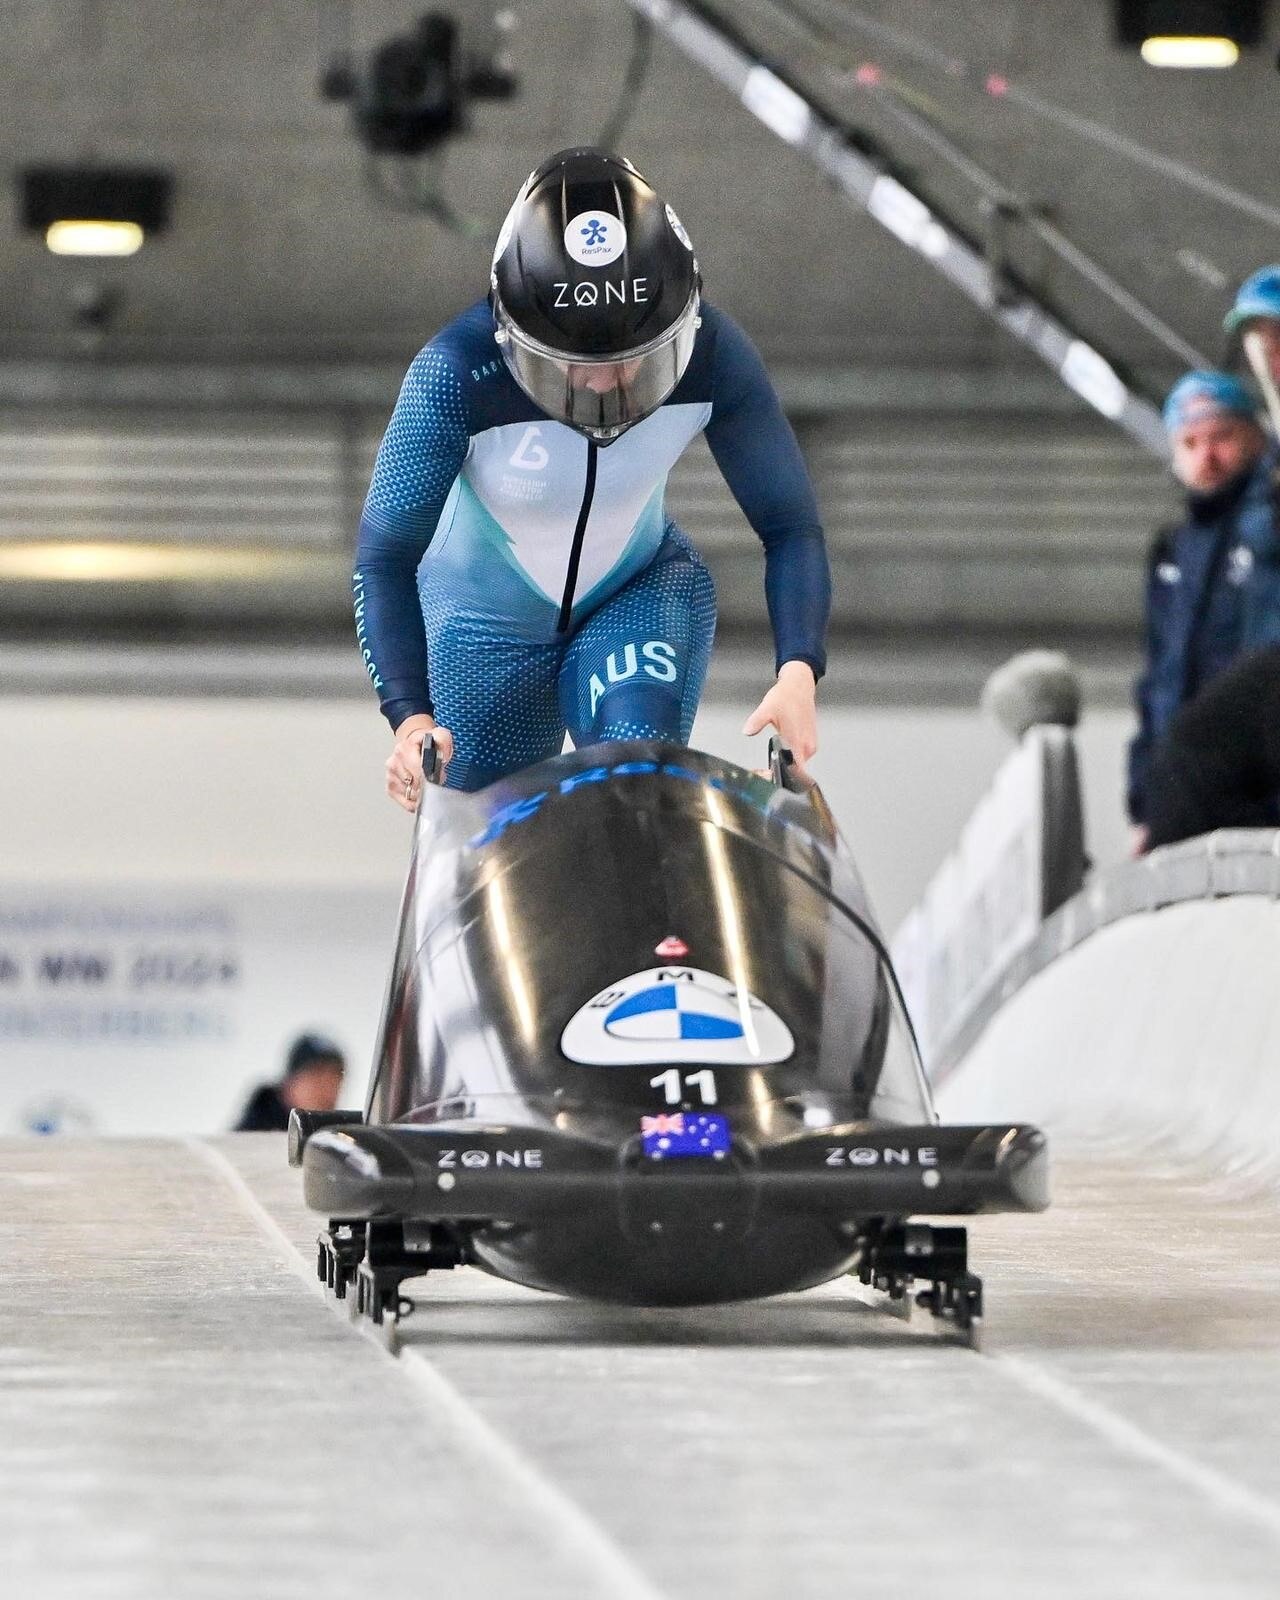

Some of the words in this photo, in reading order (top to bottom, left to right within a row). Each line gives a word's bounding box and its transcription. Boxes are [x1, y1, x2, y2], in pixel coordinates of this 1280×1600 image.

[552, 277, 649, 308] ZONE
[471, 359, 502, 382] BAB
[588, 640, 677, 718] AUS
[649, 1068, 718, 1106] 11
[437, 1149, 543, 1168] ZONE
[824, 1146, 940, 1166] ZONE
